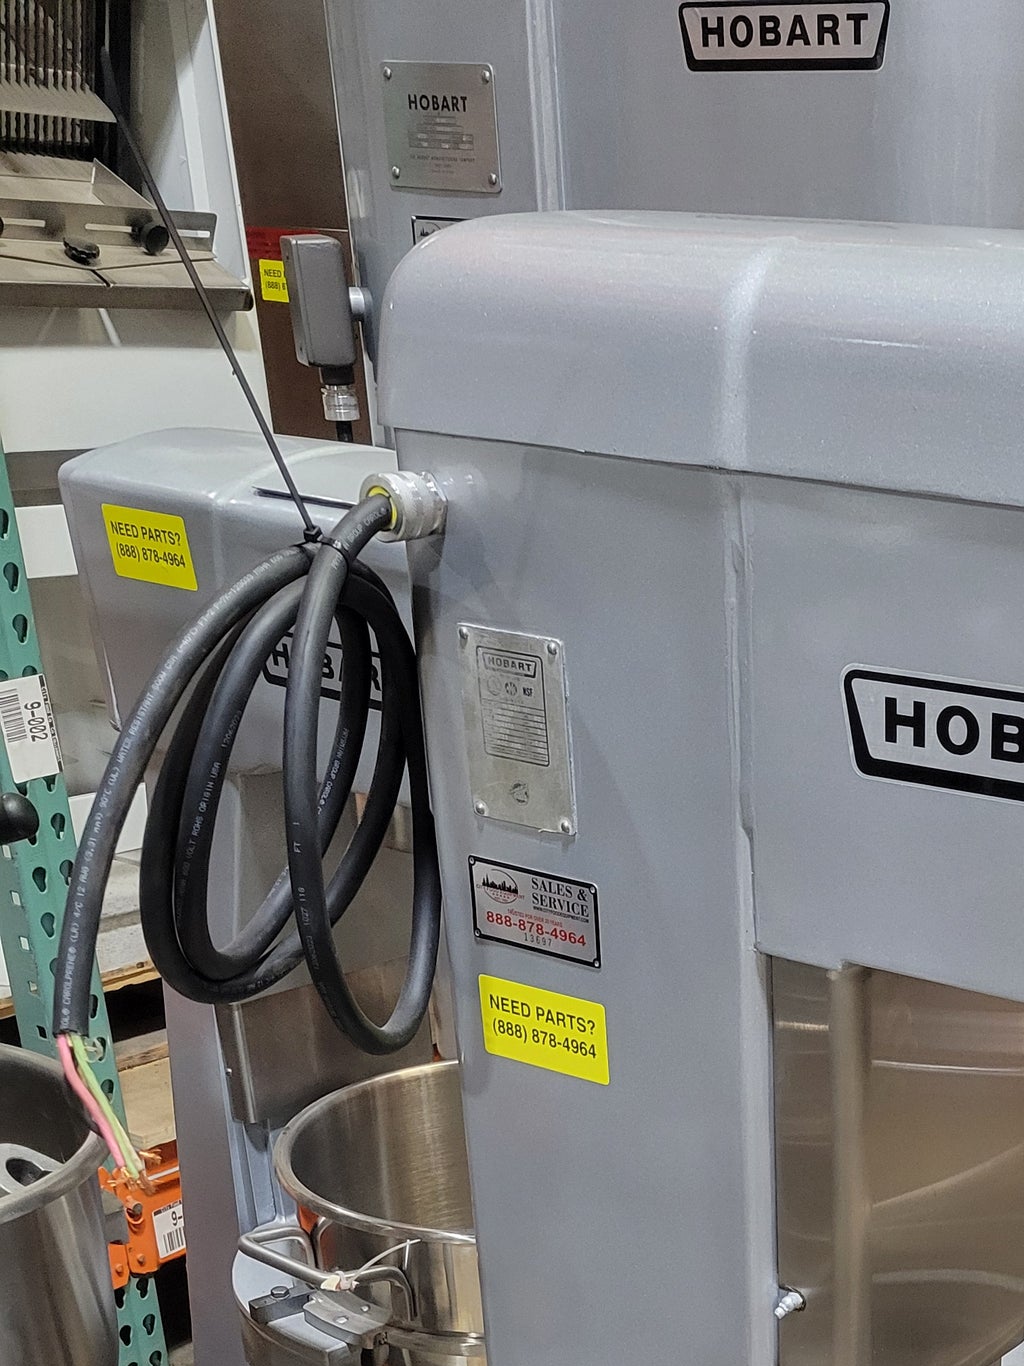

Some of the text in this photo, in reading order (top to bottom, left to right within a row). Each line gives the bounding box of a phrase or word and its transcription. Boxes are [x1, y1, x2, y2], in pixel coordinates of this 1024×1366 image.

[701, 13, 869, 48] HOBART
[407, 93, 468, 113] HOBART
[263, 268, 282, 278] NEED
[109, 520, 182, 547] NEED PARTS?
[115, 541, 187, 569] (888) 878-4964
[487, 654, 533, 674] HOBART
[522, 685, 534, 698] NSF
[24, 701, 49, 743] 9-002
[210, 761, 222, 780] USA
[293, 841, 301, 854] FT
[531, 876, 573, 899] SALES
[577, 889, 588, 903] &
[531, 892, 590, 918] SERVICE
[486, 910, 587, 947] 888-878-4964
[489, 993, 597, 1036] NEED PARTS?
[492, 1017, 597, 1059] (888) 878-4964
